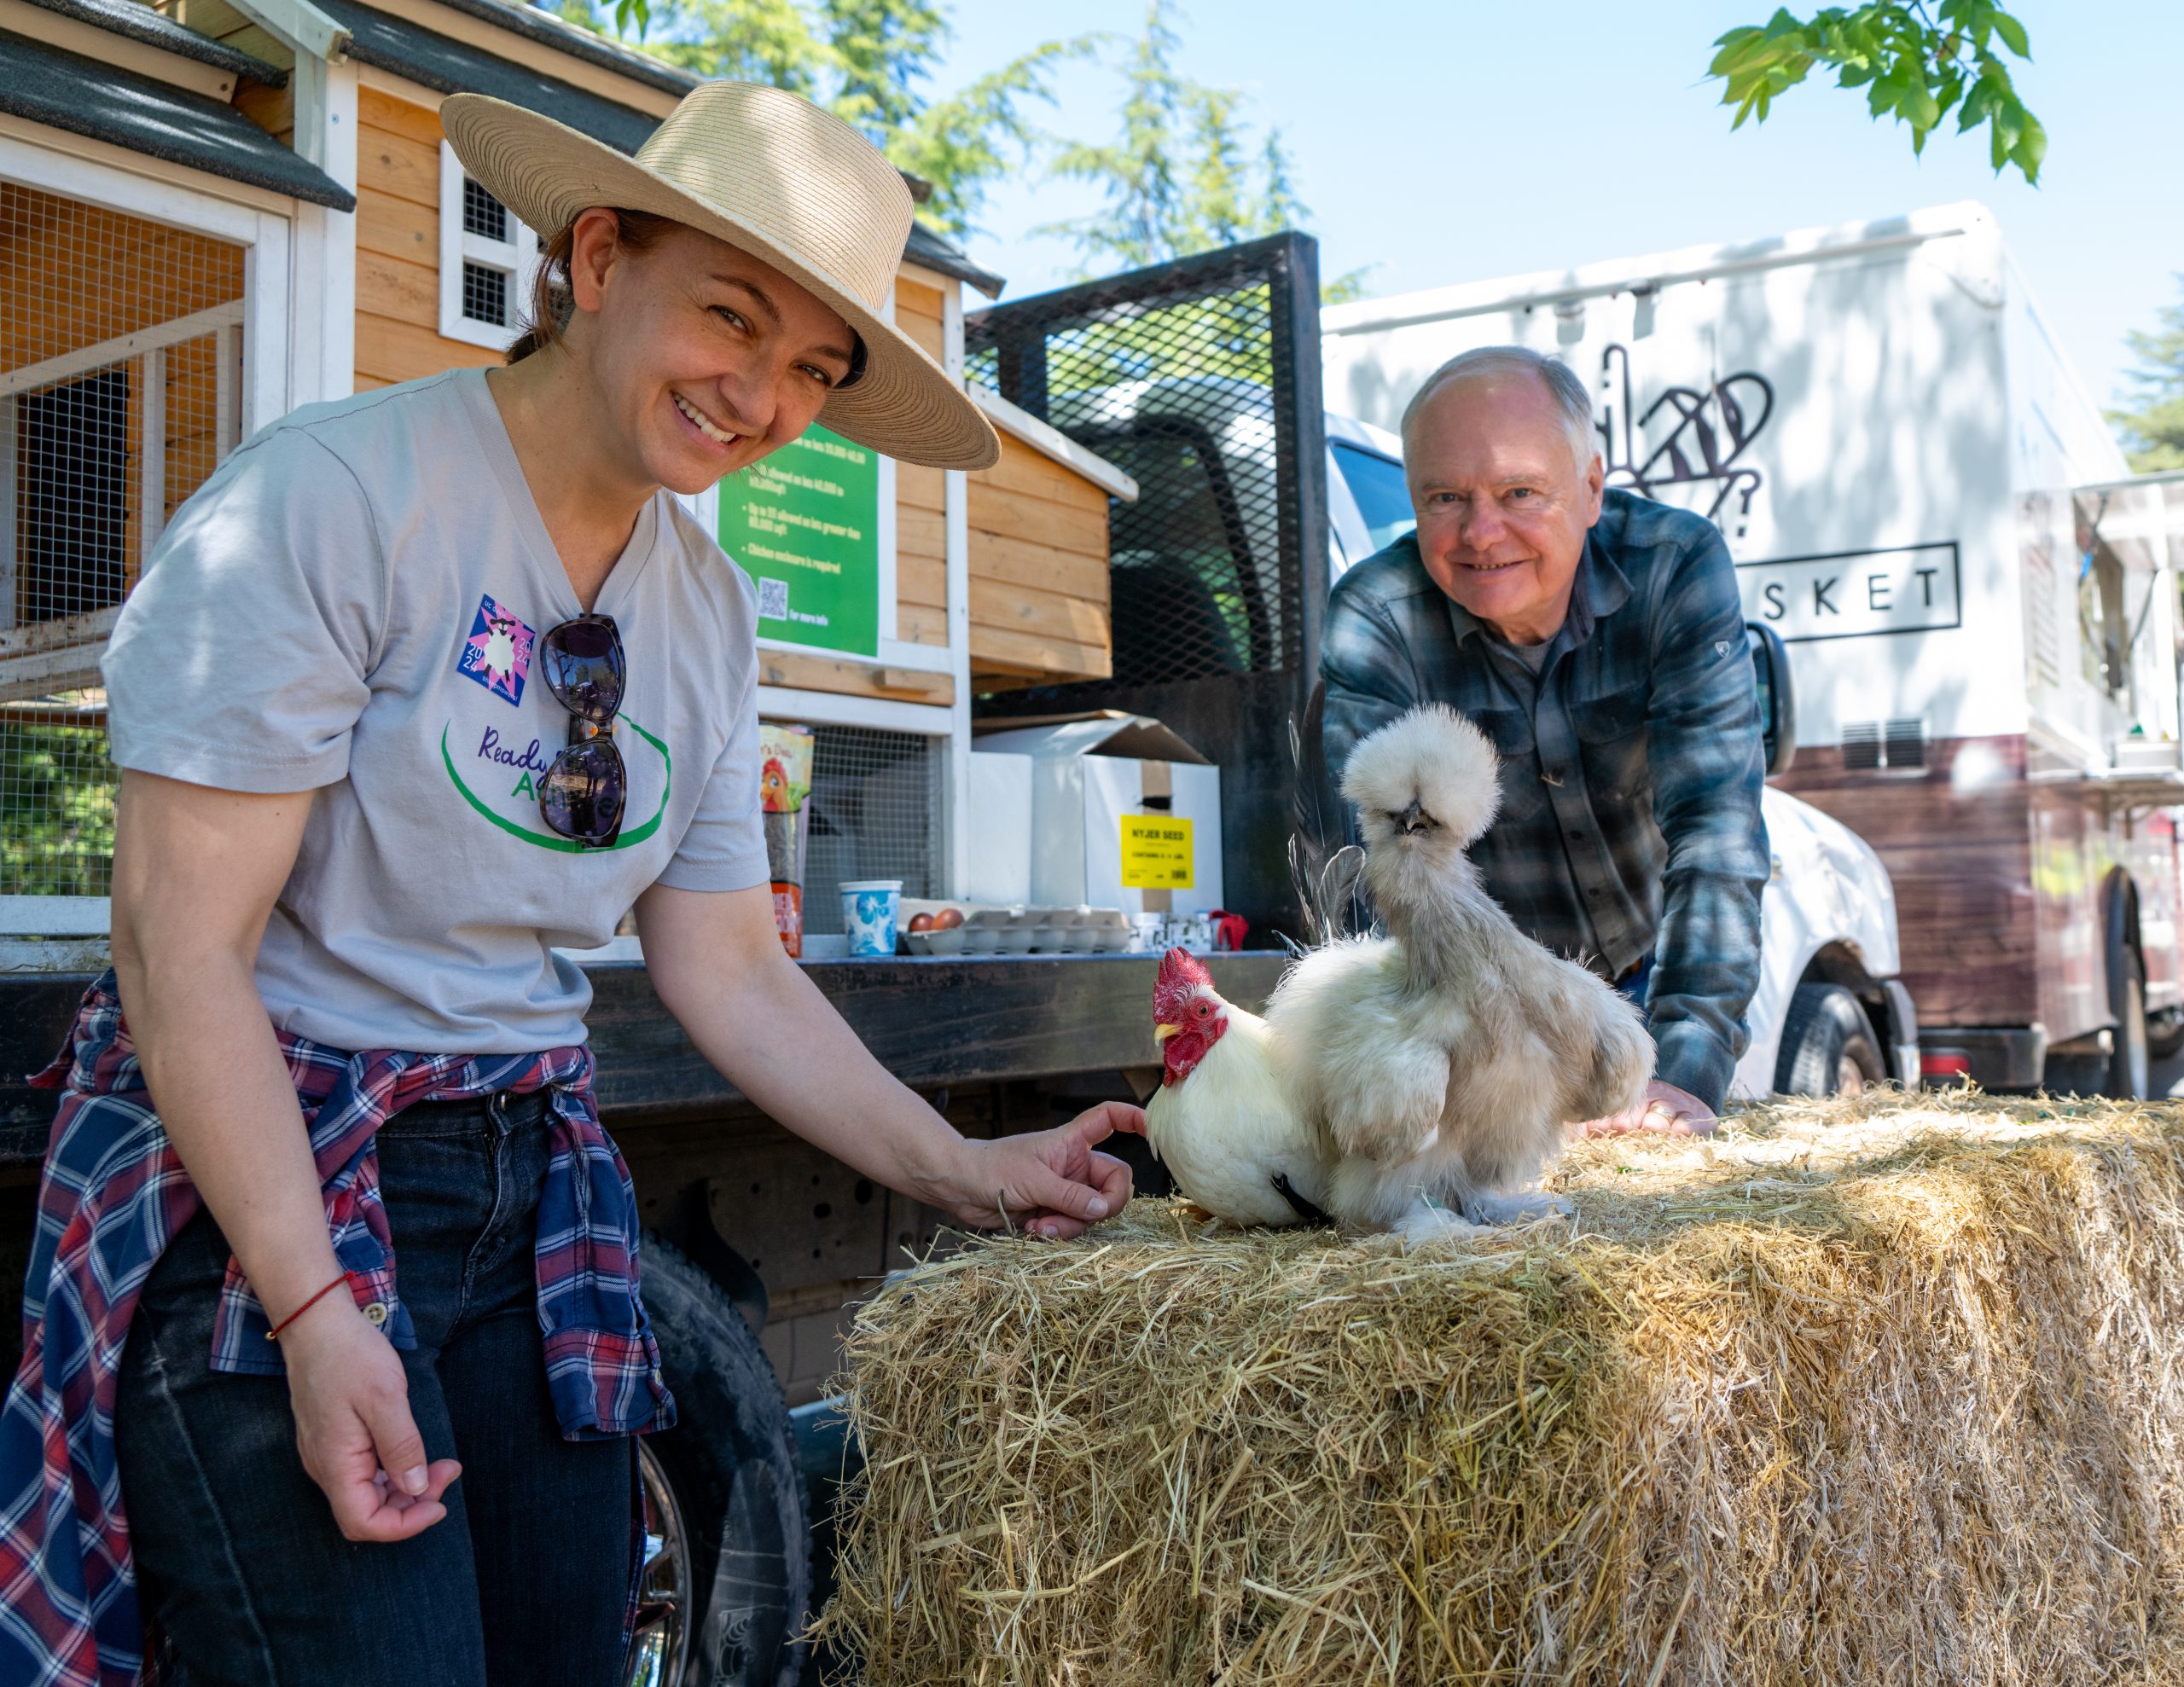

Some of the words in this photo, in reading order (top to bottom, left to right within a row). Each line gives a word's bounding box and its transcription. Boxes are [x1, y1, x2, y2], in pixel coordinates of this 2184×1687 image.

[1763, 569, 1938, 621] SKET
[468, 643, 483, 659] 20
[478, 725, 548, 791] Ready
[1163, 830, 1185, 842] SEED
